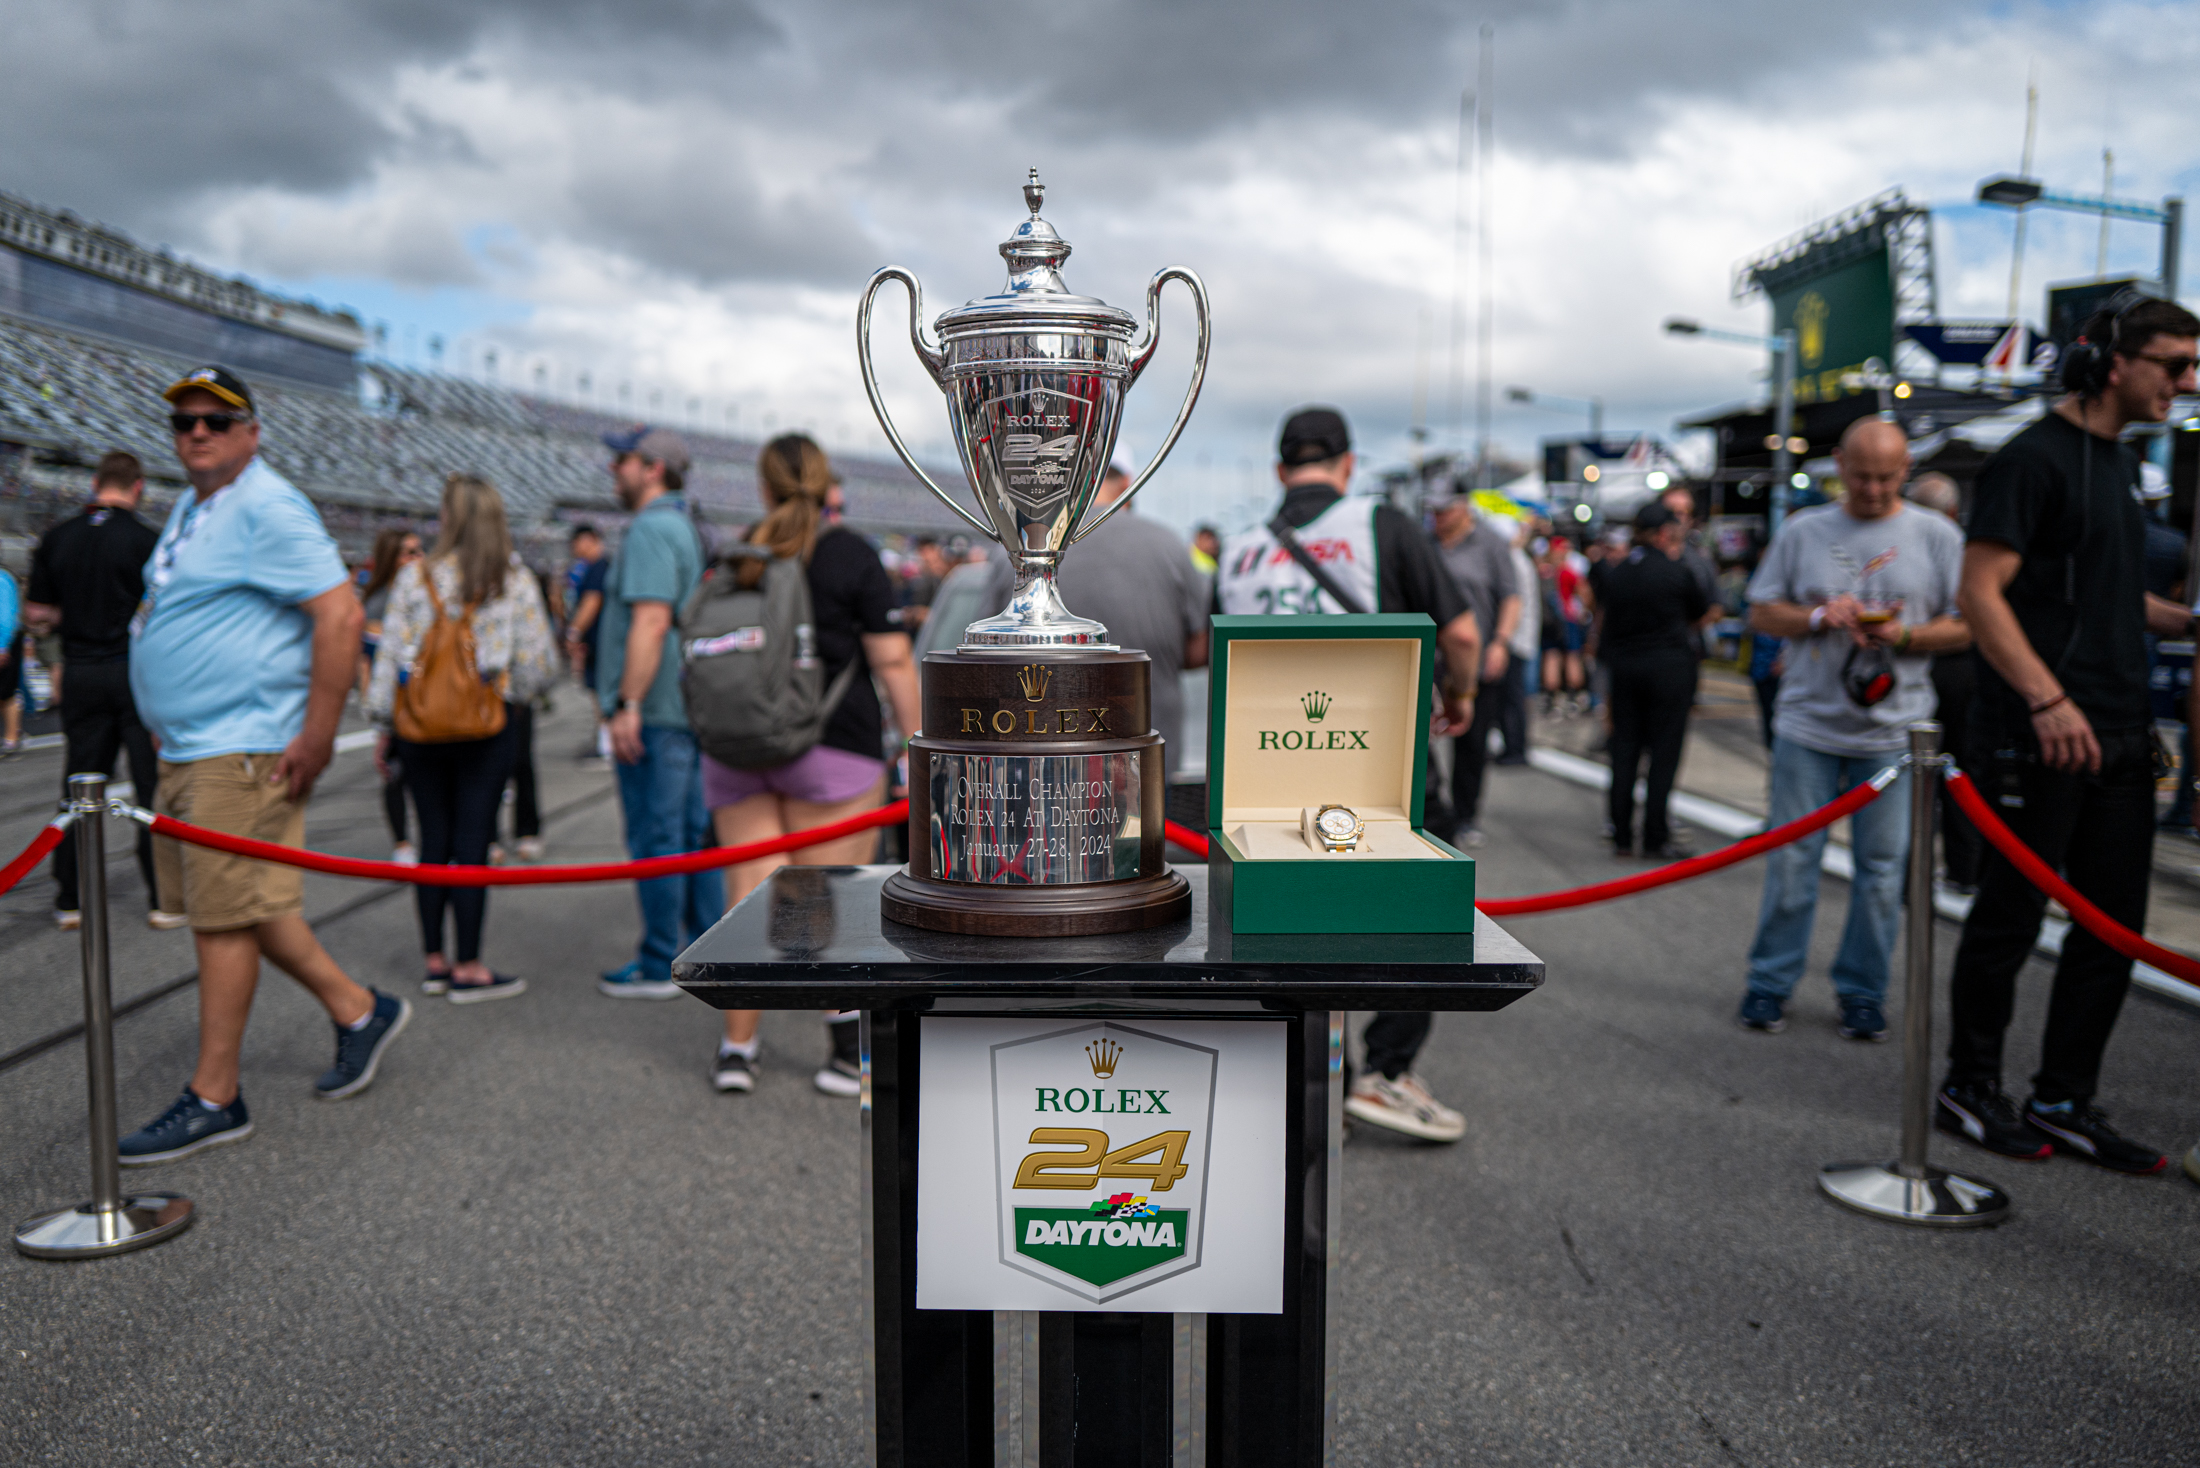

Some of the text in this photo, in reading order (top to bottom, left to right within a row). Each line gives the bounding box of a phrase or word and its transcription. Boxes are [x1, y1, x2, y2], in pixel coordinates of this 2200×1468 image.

[1007, 415, 1070, 427] ROLEX
[1002, 434, 1079, 461] 24
[1010, 474, 1065, 485] DAYTONA
[960, 708, 1111, 734] ROLEX
[1258, 730, 1370, 750] ROLEX
[957, 776, 1113, 800] OVERALL CHAMPION
[951, 803, 994, 827] ROLEX
[1000, 811, 1015, 827] 24
[1050, 806, 1120, 828] DAYTONA
[960, 834, 1111, 862] January 27-28, 2024
[1035, 1087, 1171, 1114] ROLEX
[1012, 1127, 1191, 1191] 24
[1025, 1219, 1177, 1247] DAYTONA
